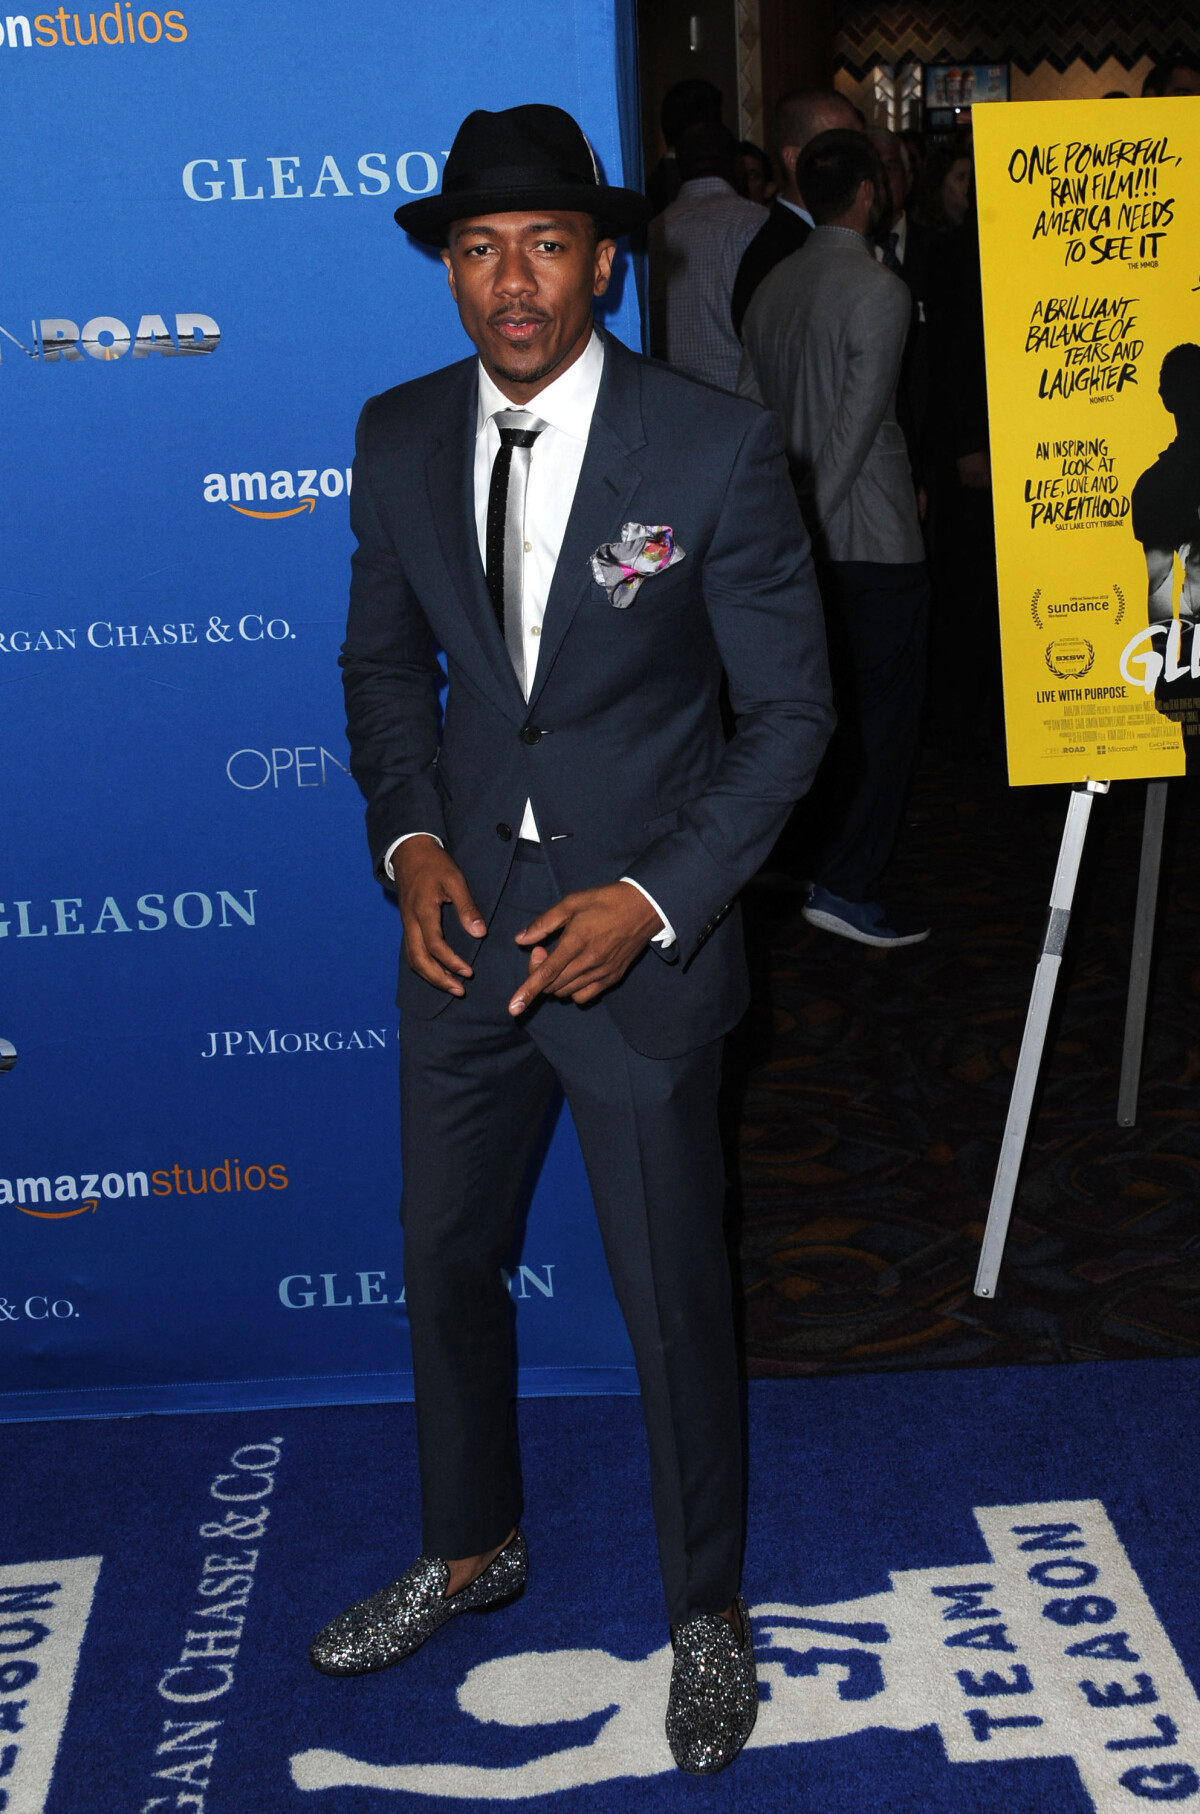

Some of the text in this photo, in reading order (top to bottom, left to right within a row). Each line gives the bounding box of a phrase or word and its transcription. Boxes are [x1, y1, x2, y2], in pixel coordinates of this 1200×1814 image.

[182, 150, 450, 202] GLEASO
[1008, 137, 1182, 185] ONE POWERFUL,
[1050, 167, 1157, 208] RAW FILM!!!
[1032, 198, 1175, 240] AMERICA NEEDS
[1065, 232, 1167, 266] TO SEE IT
[1128, 262, 1139, 270] THE
[1031, 295, 1140, 324] A BRILLIANT
[1025, 316, 1138, 353] BALANCE OF
[1064, 340, 1144, 367] TEARS AND
[1038, 363, 1138, 400] LAUGHTER
[1036, 438, 1108, 461] AN INSPIRING
[1061, 457, 1116, 476] LOOK AT
[203, 467, 352, 503] amazo
[1025, 475, 1118, 503] LIFE, LOVE AND
[1031, 495, 1130, 529] PARENTHOOD
[1055, 523, 1069, 531] SALT
[1100, 520, 1124, 528] TRIBUNE
[1047, 601, 1109, 614] sundance
[87, 621, 198, 649] CHASE
[205, 616, 234, 643] &
[1055, 654, 1086, 662] SXSW
[1036, 686, 1129, 704] LIVE WITH PURPOSE.
[0, 889, 258, 938] LEASON
[199, 1505, 271, 1540] &
[931, 1583, 1043, 1742] TEAM
[1010, 1521, 1200, 1801] GLEASON
